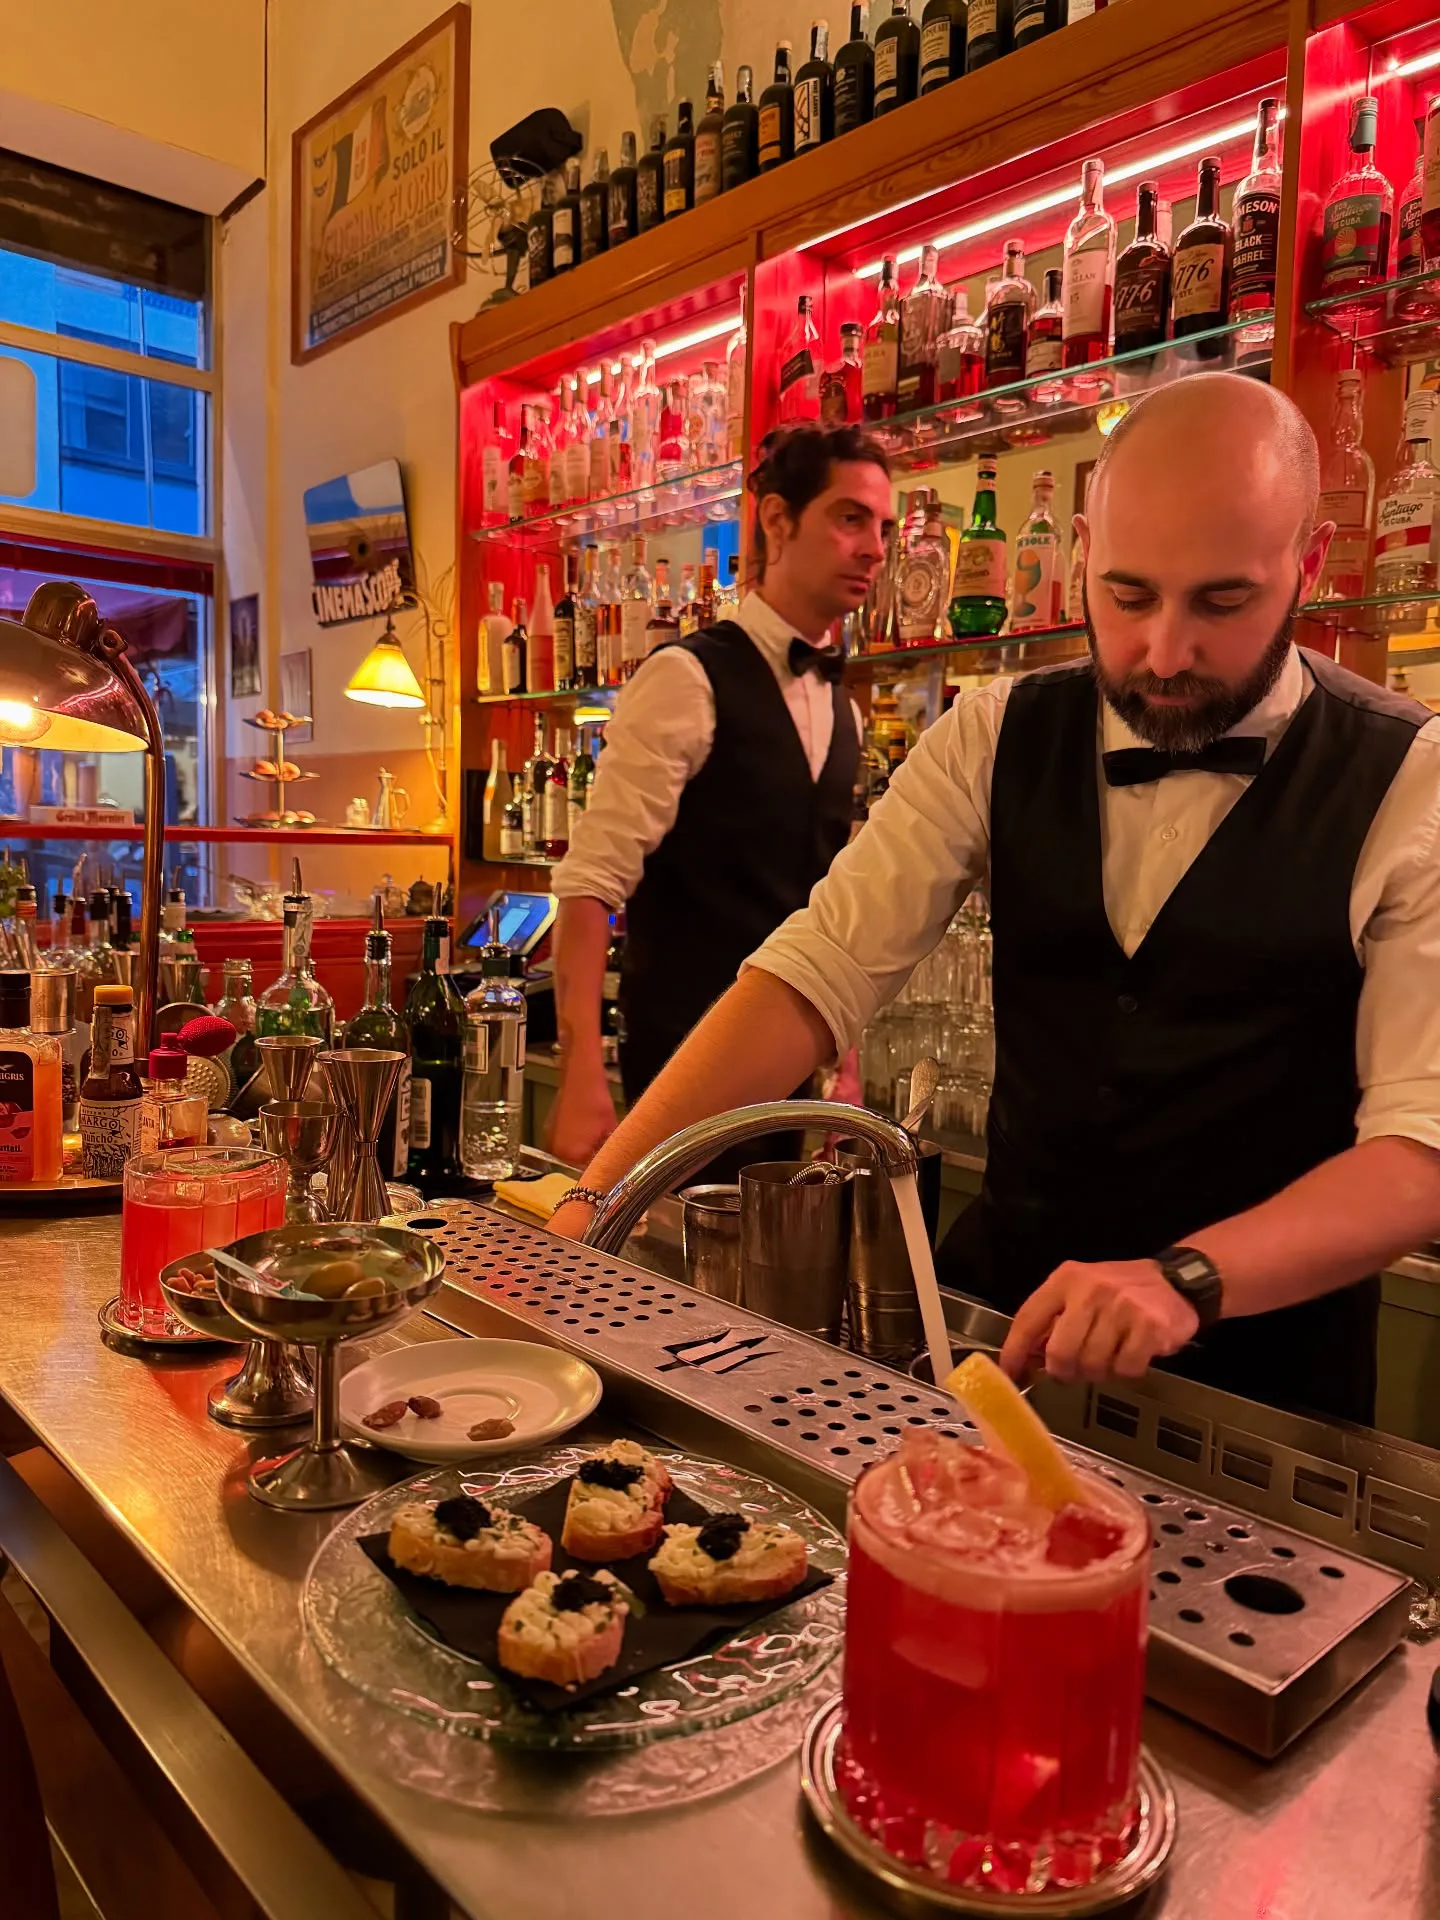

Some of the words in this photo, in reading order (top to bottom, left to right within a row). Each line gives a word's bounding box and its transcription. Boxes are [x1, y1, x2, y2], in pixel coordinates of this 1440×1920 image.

[393, 138, 427, 180] SOLO
[430, 128, 445, 155] IL
[1341, 217, 1361, 226] CUBA
[1234, 234, 1262, 252] BLACK
[1232, 250, 1264, 268] BARREL
[1378, 503, 1423, 524] Santiago
[1390, 517, 1412, 526] CUBA
[81, 1115, 118, 1129] MARGO
